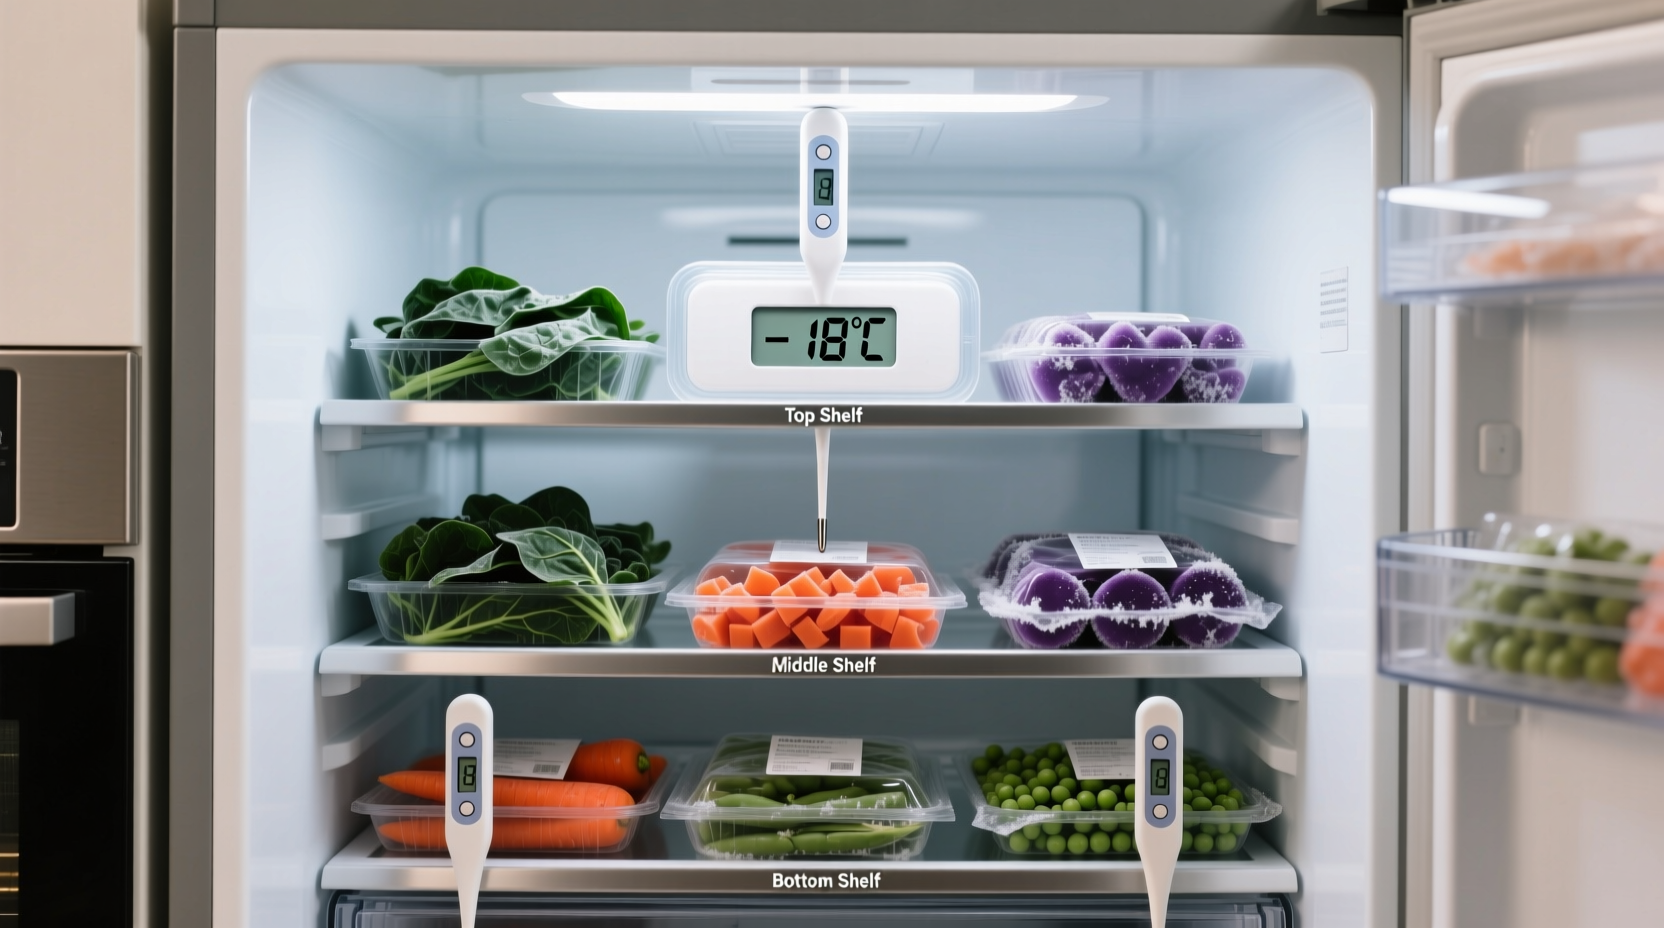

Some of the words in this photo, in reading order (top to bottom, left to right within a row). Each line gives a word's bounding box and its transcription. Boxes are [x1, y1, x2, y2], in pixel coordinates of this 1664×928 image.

[784, 407, 816, 427] Top
[820, 406, 863, 423] Shelf
[771, 656, 828, 673] Middle
[832, 656, 876, 673] Shelf
[772, 872, 833, 888] Bottom
[838, 872, 881, 888] Shelf
